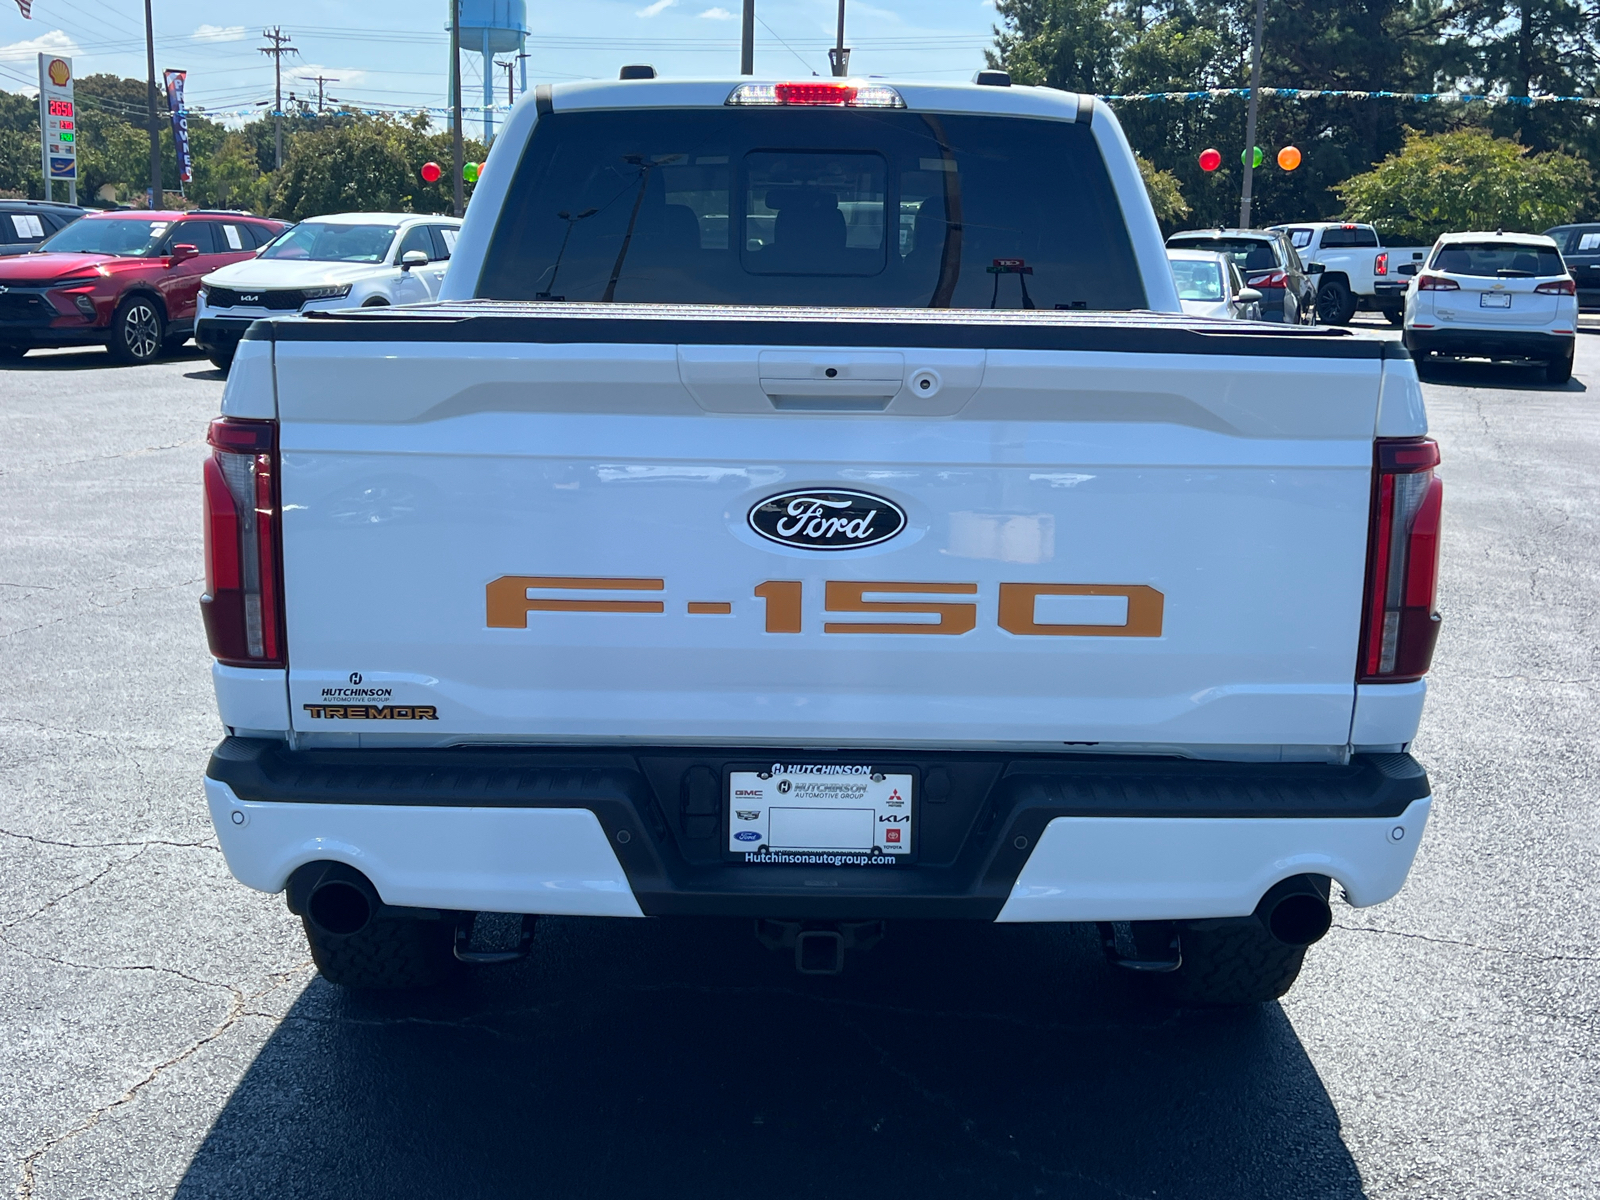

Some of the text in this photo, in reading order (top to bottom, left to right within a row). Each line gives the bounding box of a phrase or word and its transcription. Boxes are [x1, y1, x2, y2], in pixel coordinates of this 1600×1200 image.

[776, 497, 877, 539] Ford
[485, 575, 1165, 637] F-150
[321, 688, 393, 697] HUTCHINSON
[303, 704, 439, 720] TREMOR
[787, 764, 872, 775] HUTCHINSON
[794, 782, 868, 793] HUTCHINSON
[795, 792, 839, 800] AUTOMOTIVE
[879, 814, 910, 823] KIA
[745, 852, 896, 866] Hutchinsonautogroup.com
